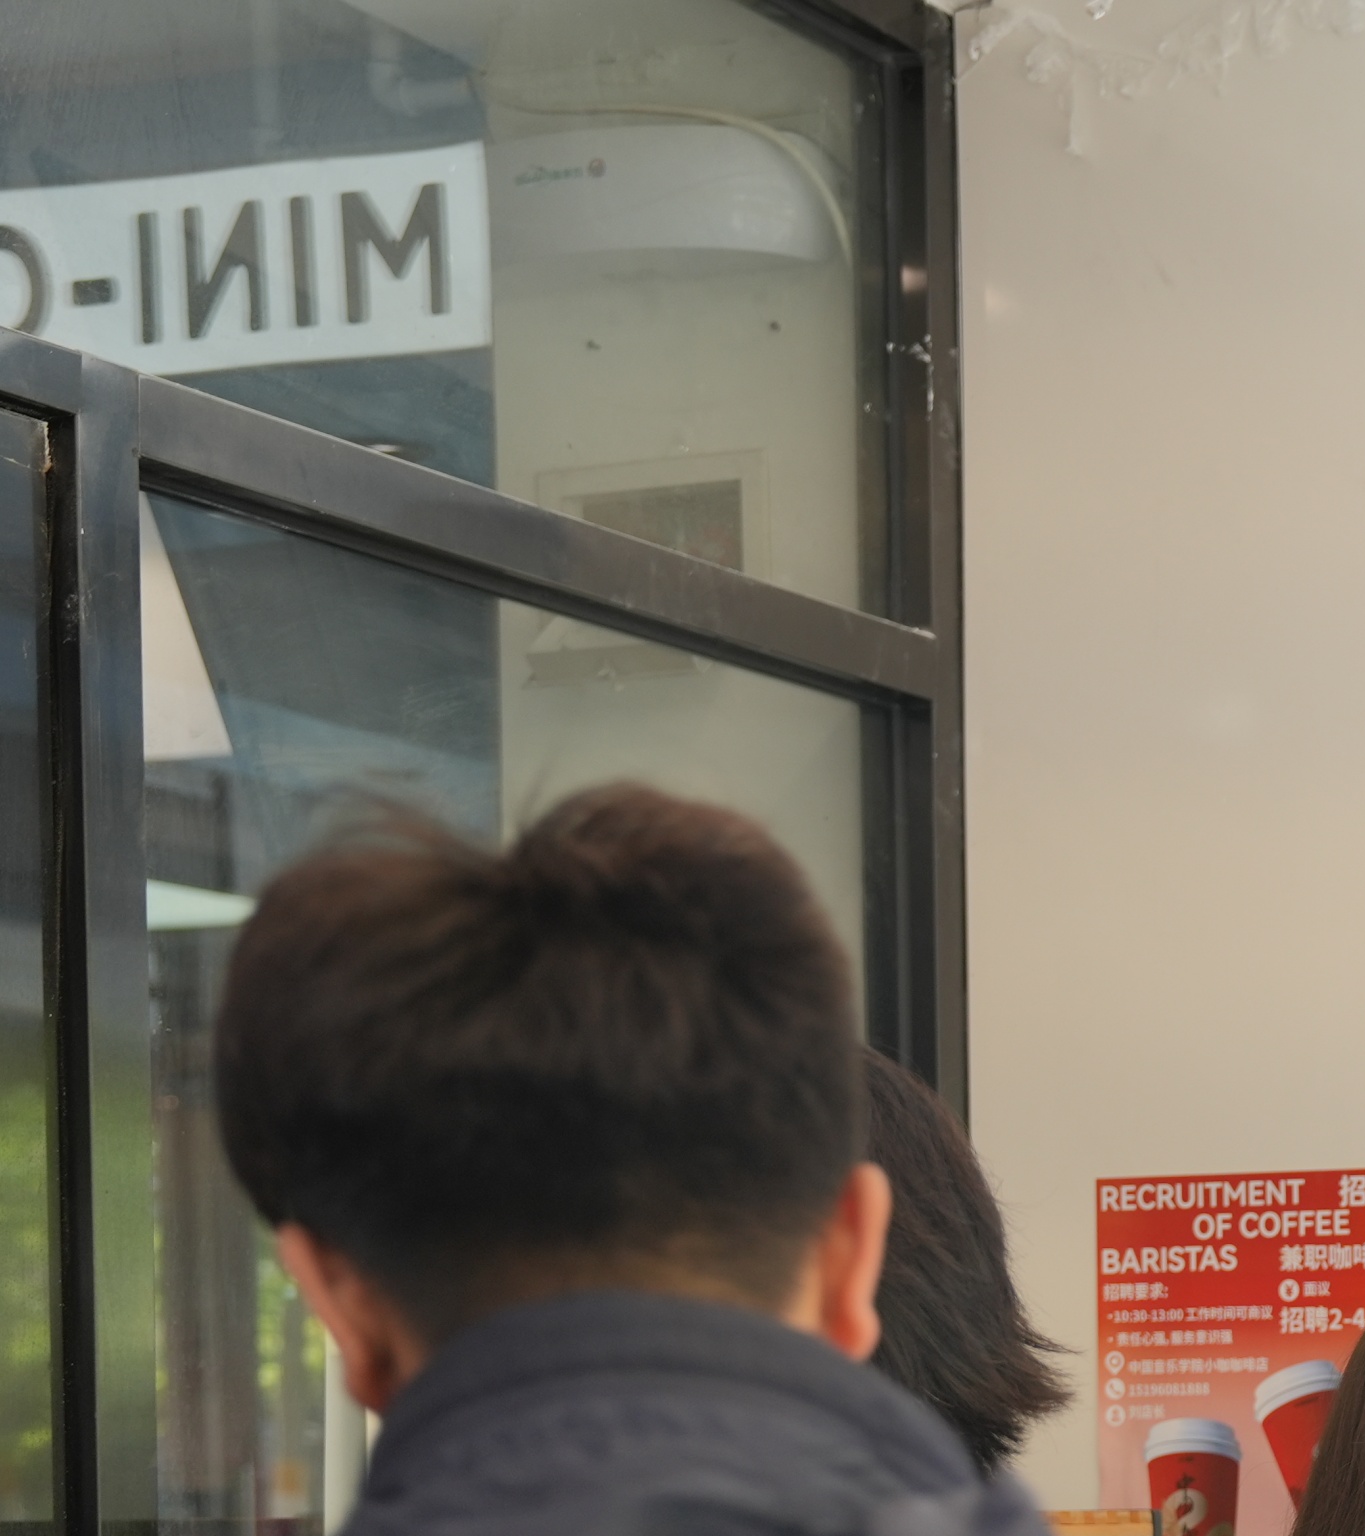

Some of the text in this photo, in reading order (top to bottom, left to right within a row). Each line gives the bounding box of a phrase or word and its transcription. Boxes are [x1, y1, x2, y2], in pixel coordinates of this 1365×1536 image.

[1101, 1179, 1305, 1212] RECRUITMENT
[1192, 1209, 1350, 1240] OF COFFEE
[1102, 1244, 1238, 1275] BARISTAS
[1303, 1281, 1331, 1296] 面议
